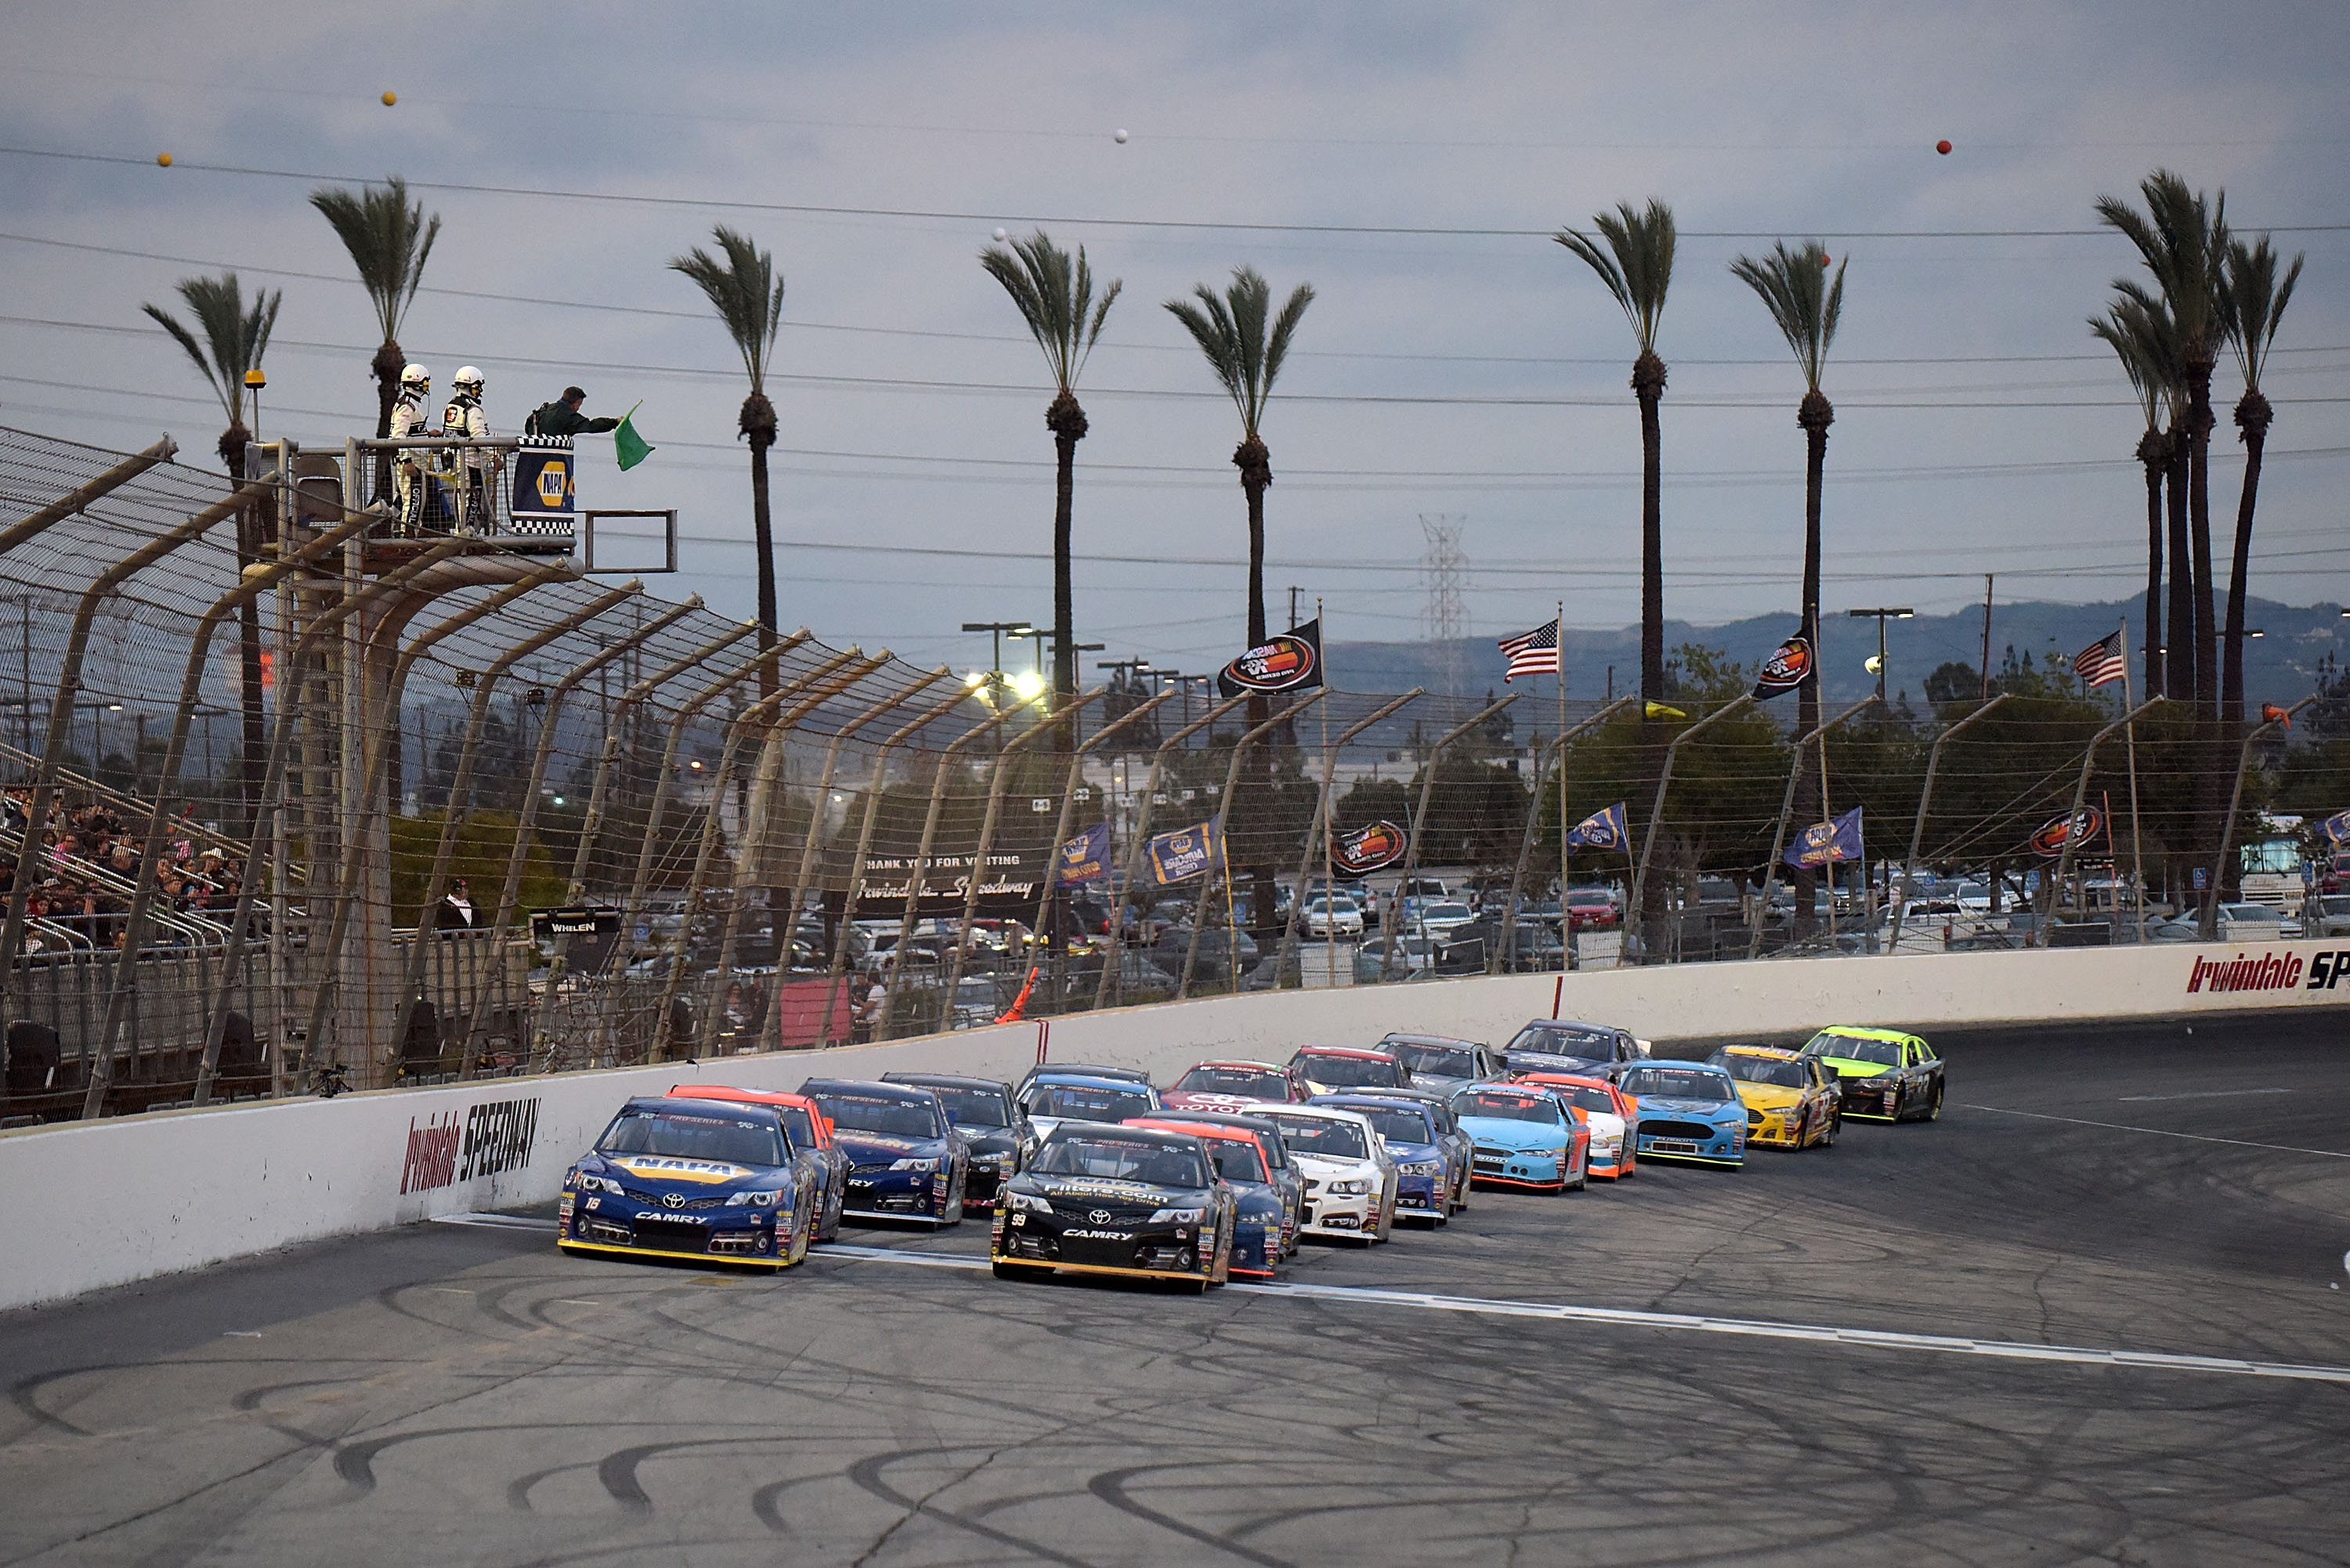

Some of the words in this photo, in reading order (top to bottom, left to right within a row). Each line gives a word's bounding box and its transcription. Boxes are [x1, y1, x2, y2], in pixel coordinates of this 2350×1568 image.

[542, 472, 563, 495] NAPA
[408, 488, 421, 524] OFFICIAL
[936, 857, 960, 867] FOR
[965, 855, 1021, 866] VIITING
[857, 878, 939, 899] Irwindle
[551, 922, 595, 933] WHELEN
[2186, 951, 2303, 993] Irwindale
[1175, 1104, 1247, 1115] TOYOT
[690, 1116, 725, 1125] SERIES
[400, 1110, 461, 1196] Irwindale
[459, 1097, 542, 1182] SPEEDWAY
[1473, 1154, 1509, 1164] SION
[634, 1158, 732, 1176] NAPA
[1044, 1184, 1169, 1203] Filters.com
[584, 1197, 602, 1210] 16
[1136, 1198, 1161, 1207] Drive
[634, 1212, 708, 1224] CAMRY
[1011, 1214, 1027, 1227] 99
[1062, 1229, 1133, 1241] CAMRY
